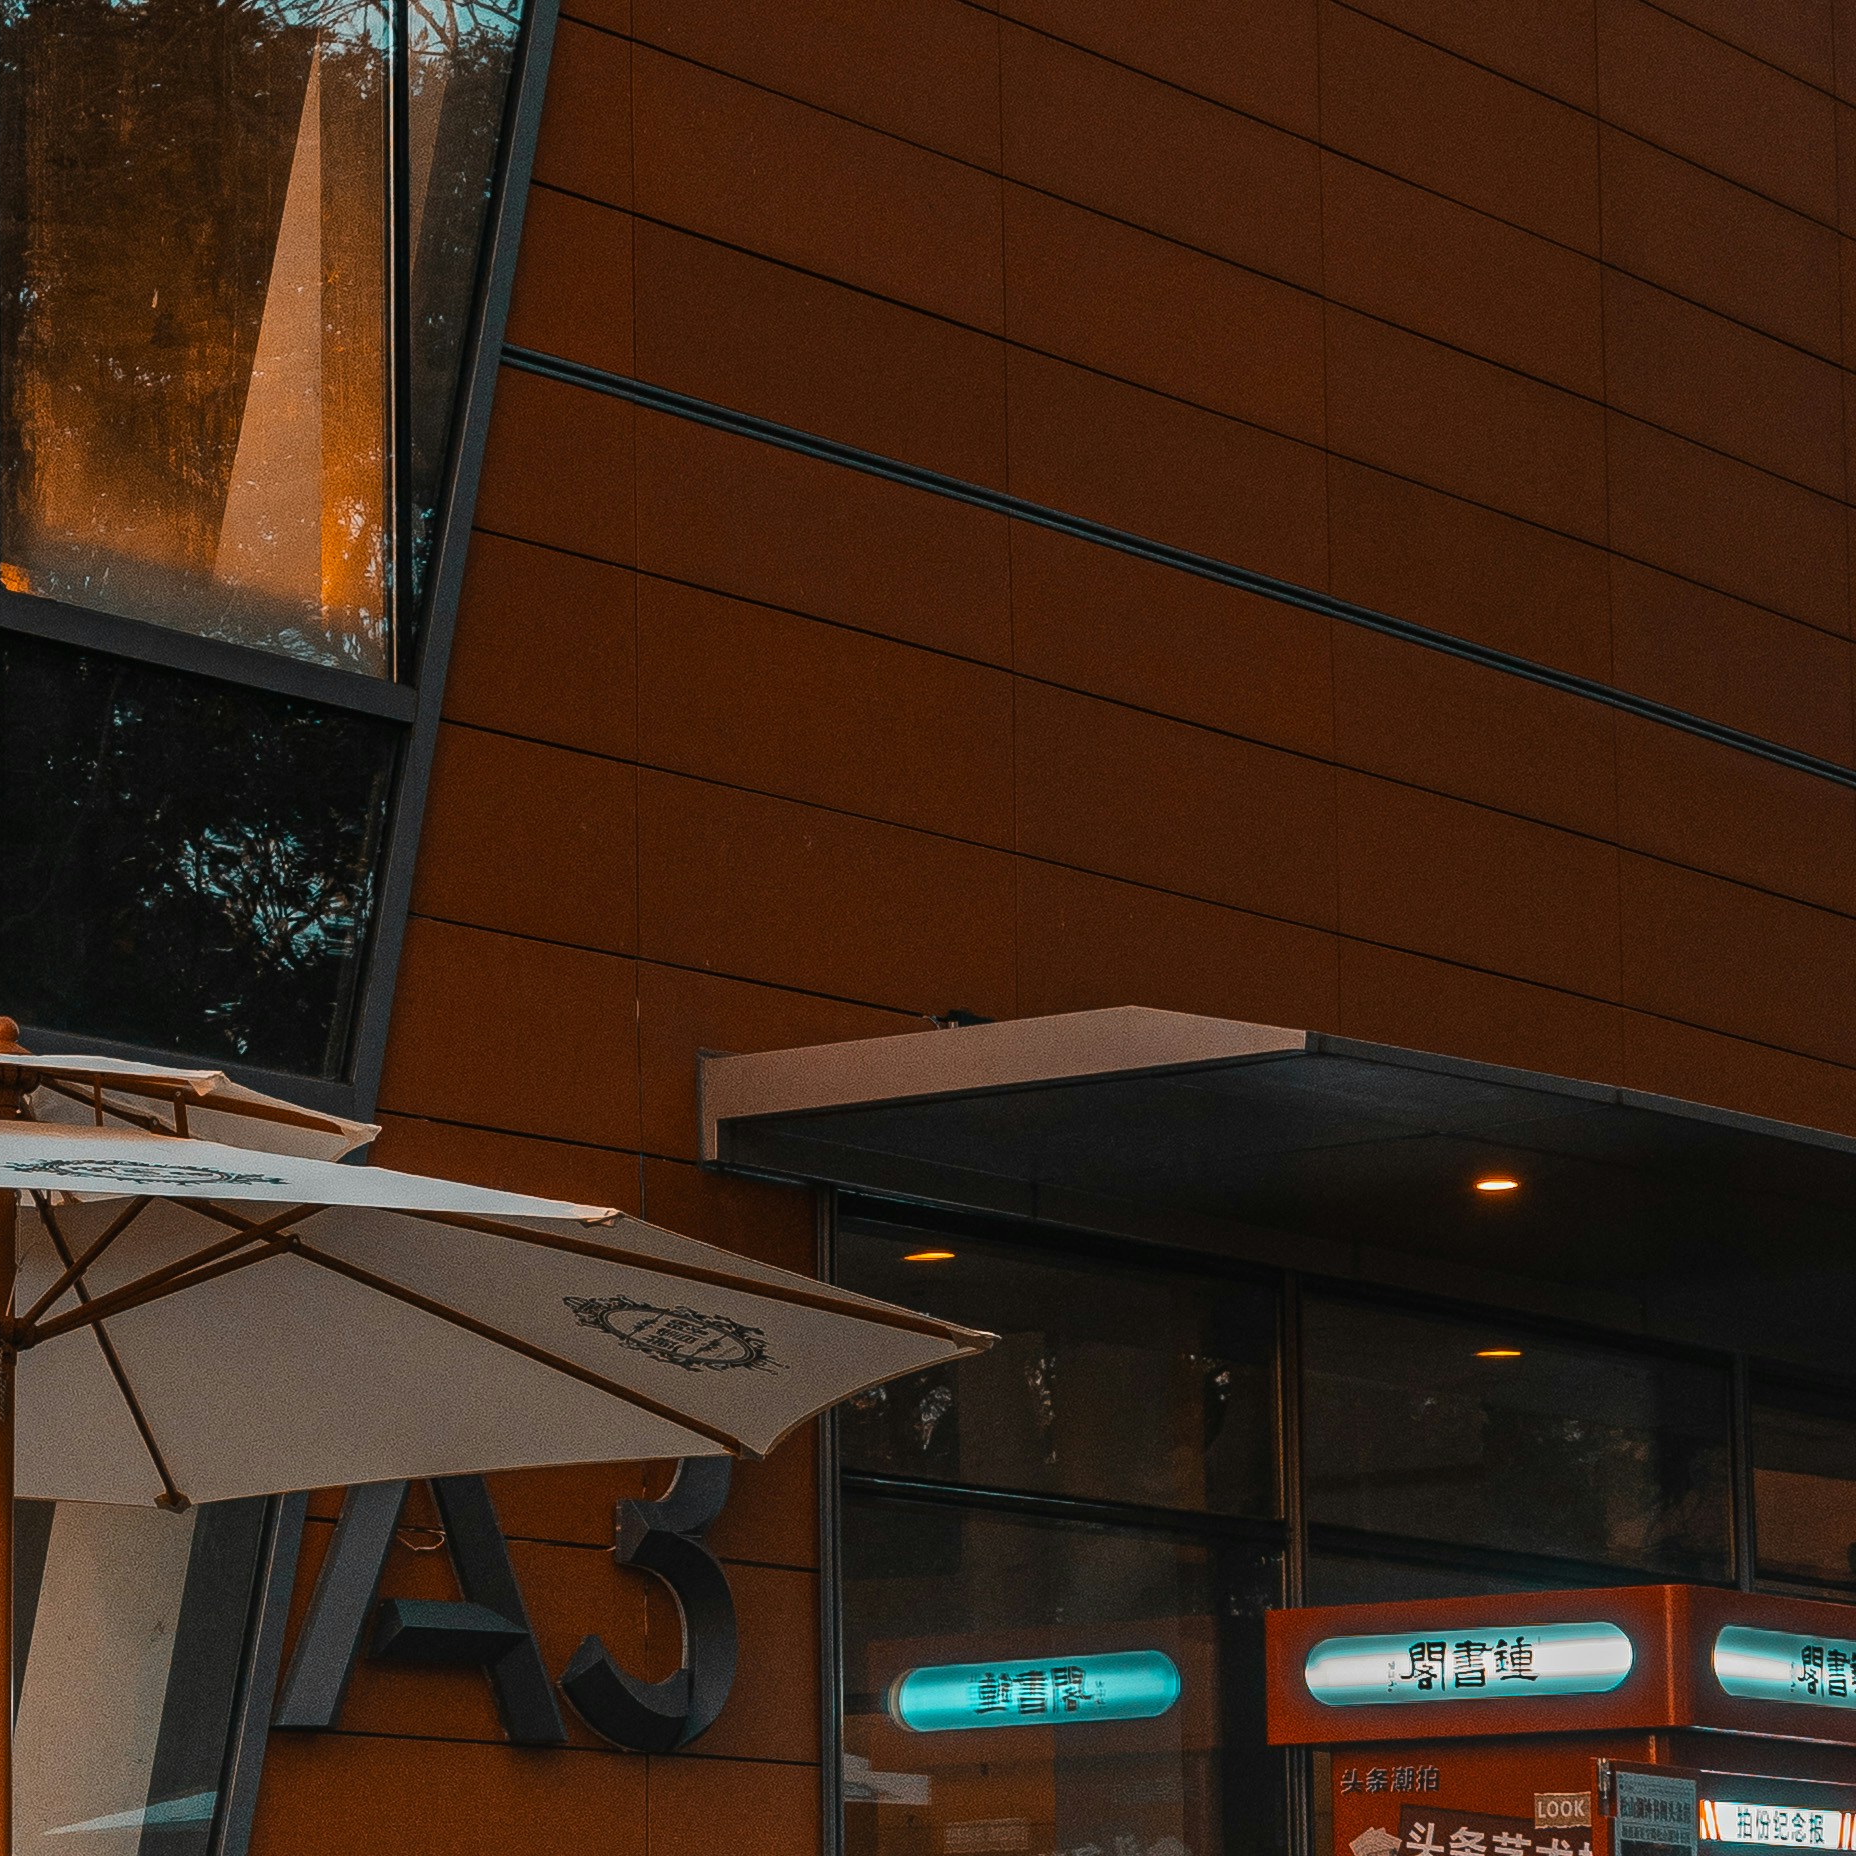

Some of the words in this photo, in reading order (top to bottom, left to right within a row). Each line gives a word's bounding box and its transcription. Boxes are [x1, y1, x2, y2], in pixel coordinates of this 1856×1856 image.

[271, 1456, 739, 1751] A3
[1341, 1764, 1440, 1794] 头条潮拍
[1538, 1800, 1585, 1819] LOOK
[1736, 1805, 1825, 1844] 拍份纪念报
